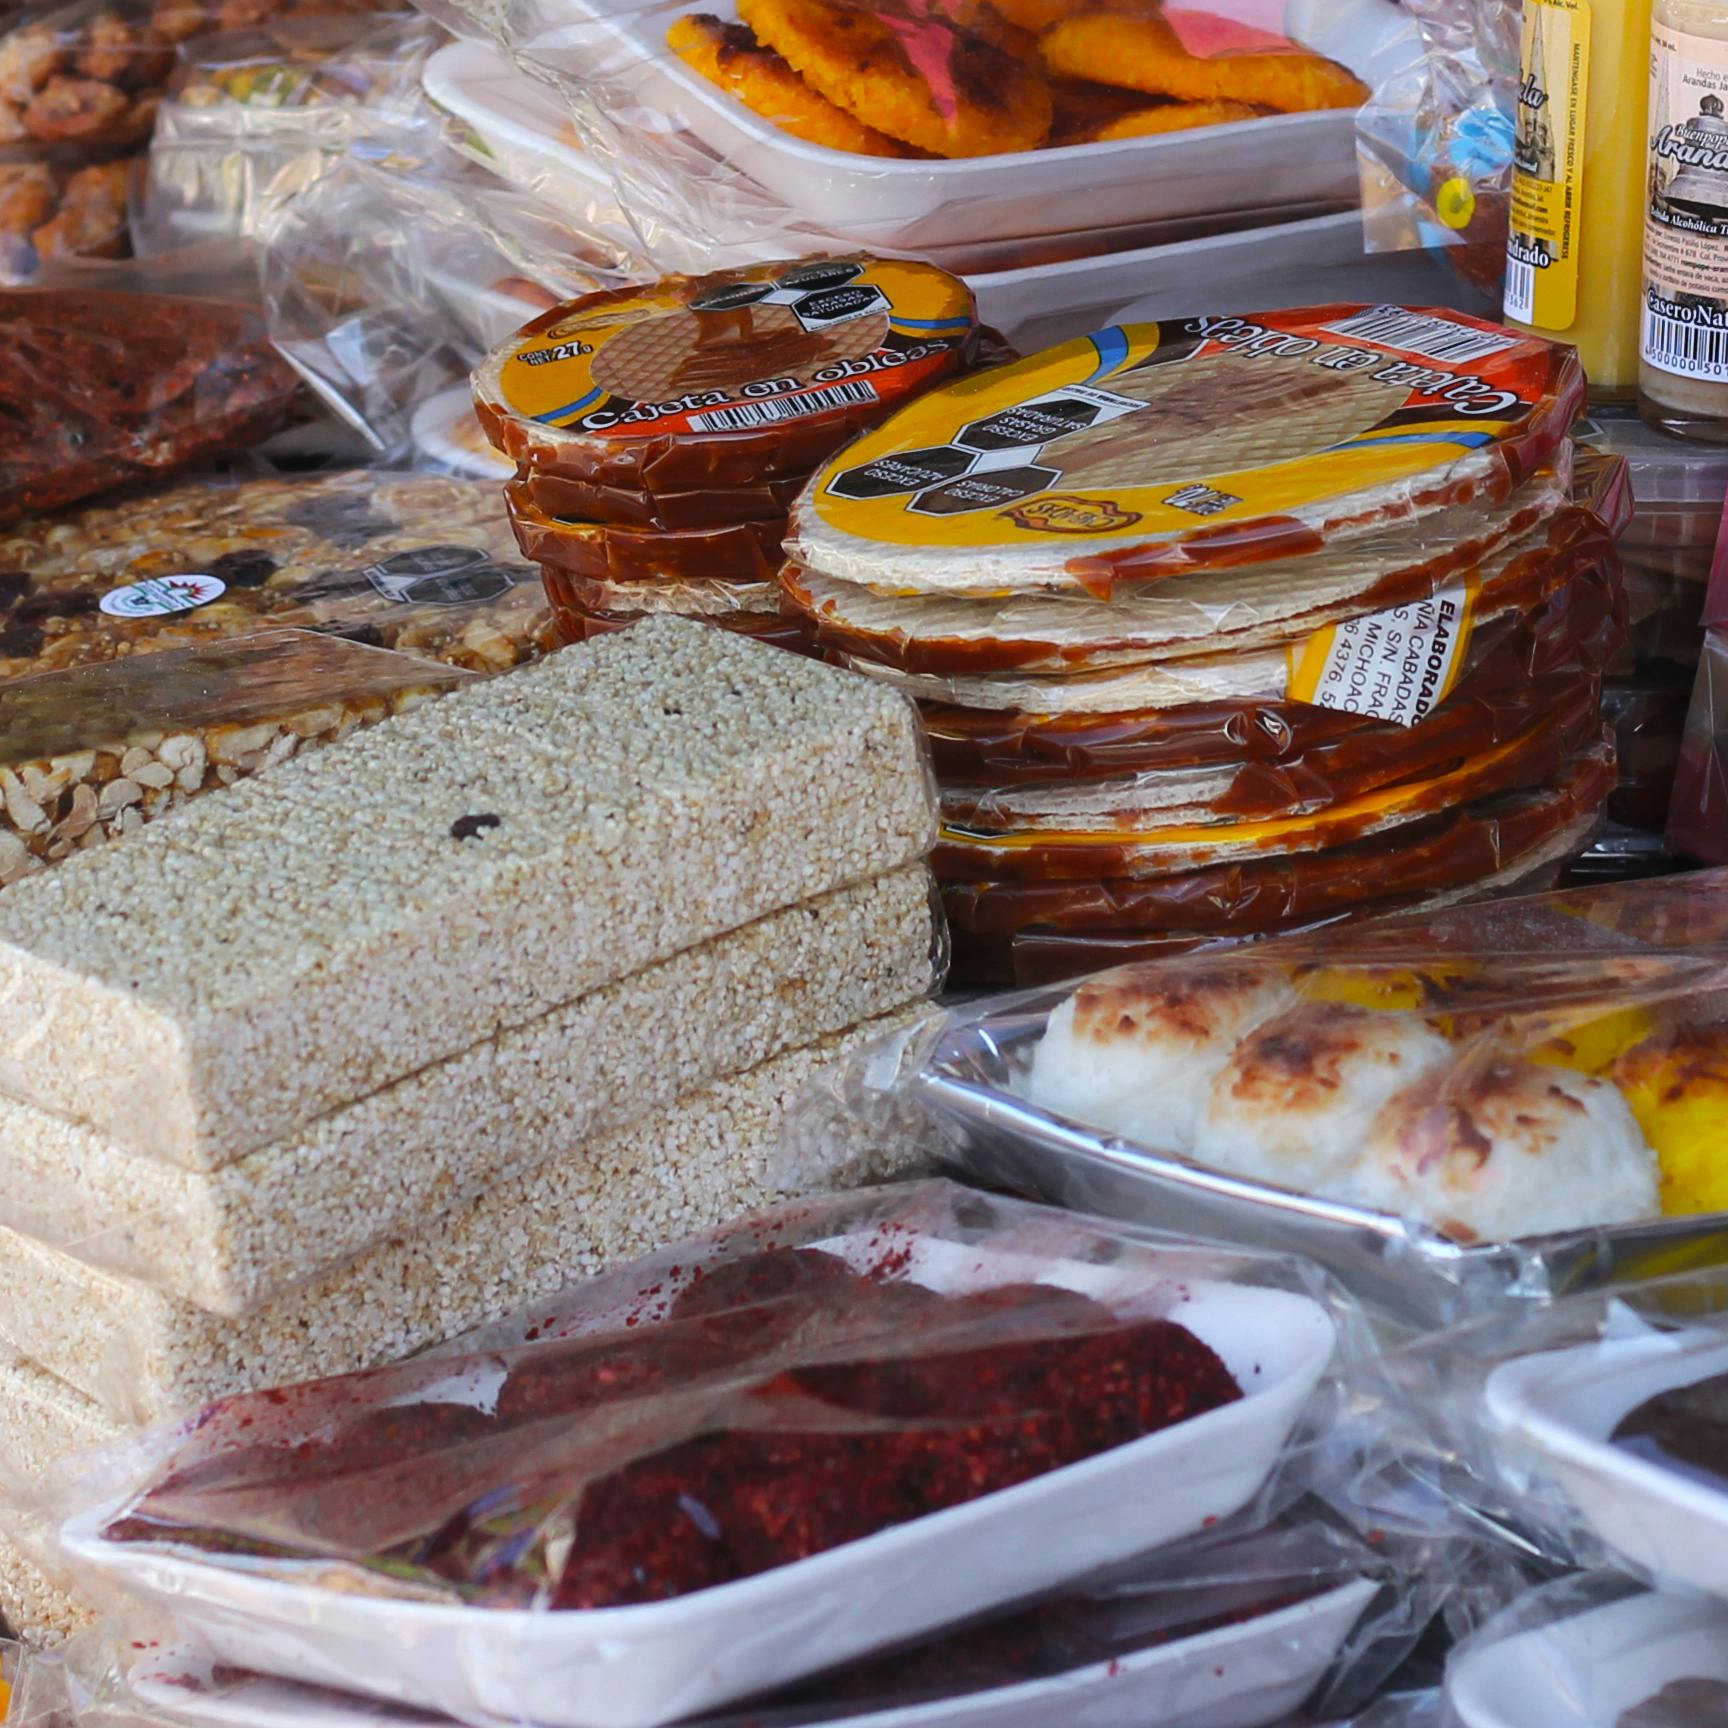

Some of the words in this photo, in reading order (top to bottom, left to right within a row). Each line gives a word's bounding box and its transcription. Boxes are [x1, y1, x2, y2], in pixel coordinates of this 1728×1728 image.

[1682, 74, 1718, 91] Arandas
[1696, 68, 1722, 82] Hecho
[1670, 212, 1718, 235] Alcohólica
[1648, 288, 1692, 322] Casero
[1182, 313, 1320, 359] obleas
[1310, 344, 1385, 373] en
[581, 384, 731, 432] Cajeta
[751, 374, 802, 398] en
[808, 336, 951, 385] obleas
[1371, 360, 1519, 416] Cajeta
[999, 416, 1058, 435] GRASAS
[1005, 407, 1088, 432] SATURADAS
[981, 424, 1040, 443] EXCESO
[863, 470, 922, 488] EXCESO
[943, 487, 1001, 504] EXCESO
[1342, 622, 1383, 713] MICHOAC
[1387, 634, 1425, 726] CABADAS
